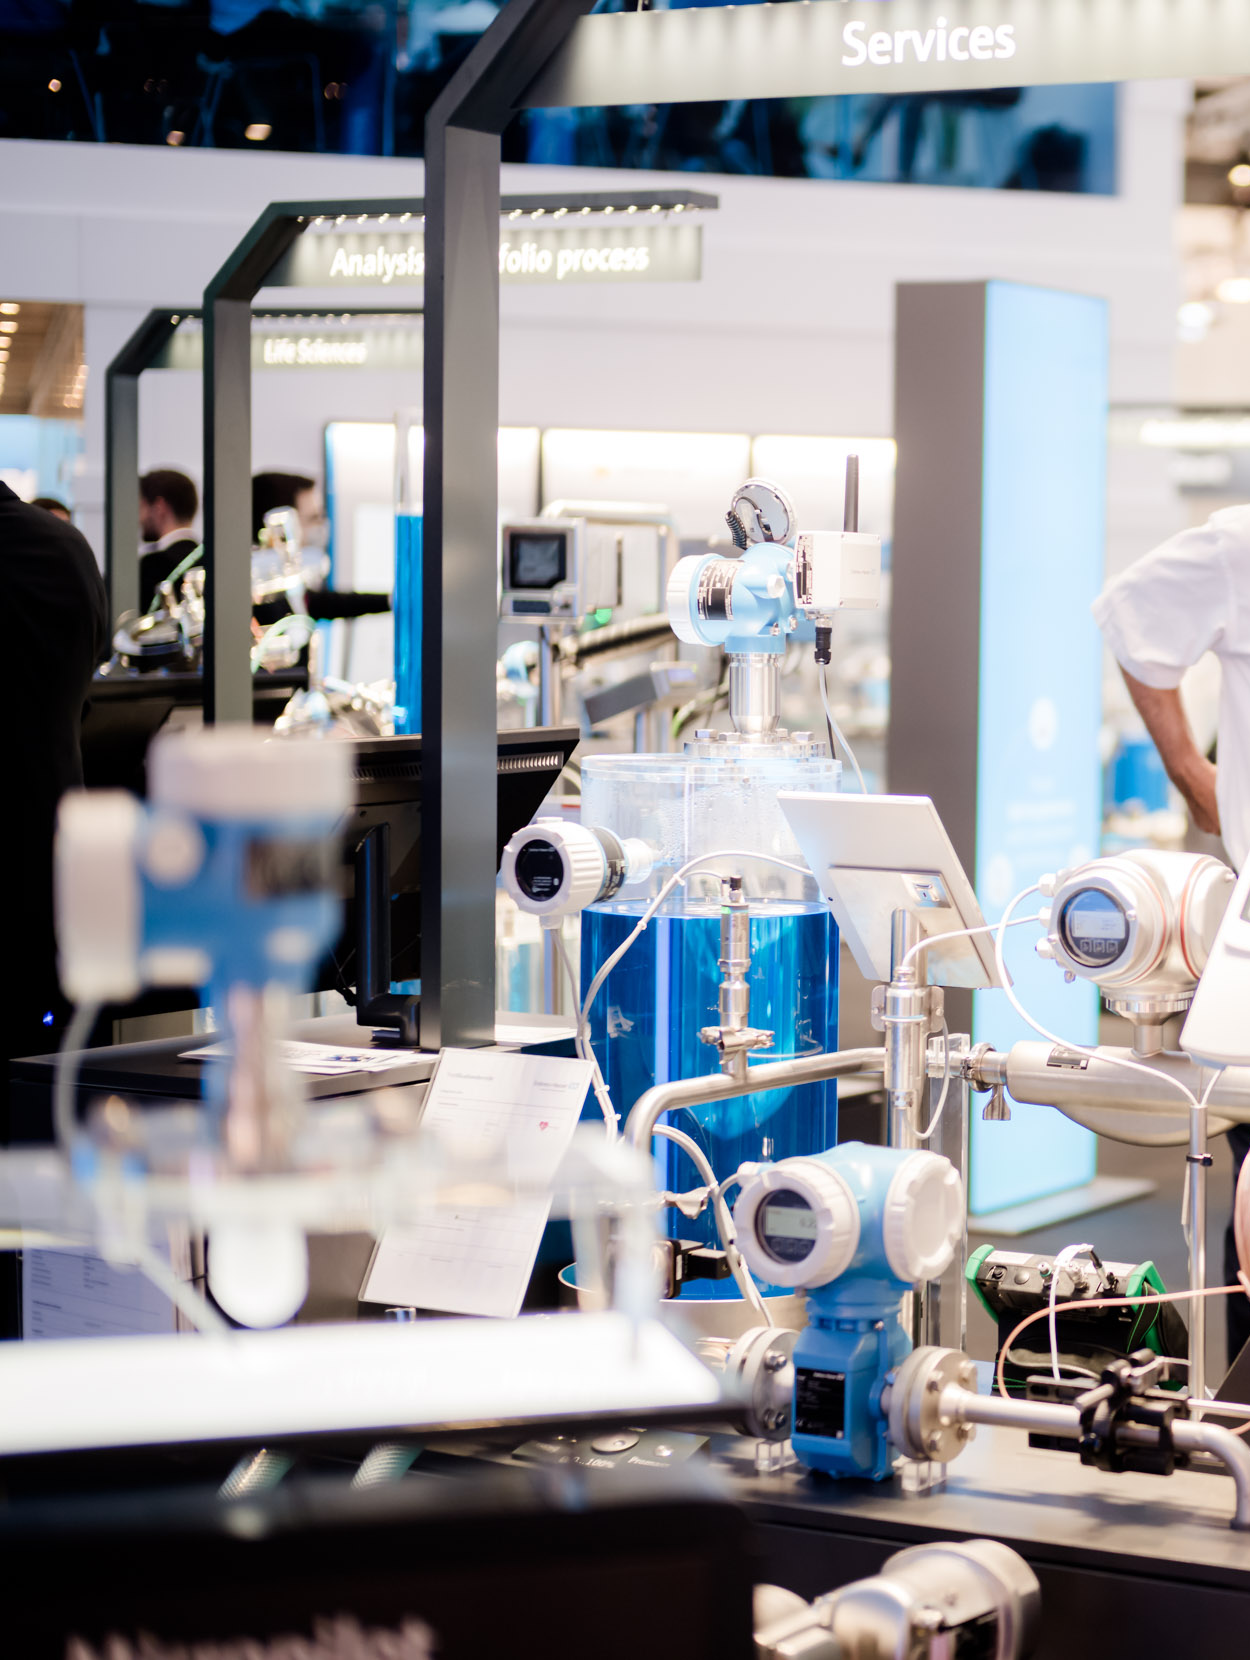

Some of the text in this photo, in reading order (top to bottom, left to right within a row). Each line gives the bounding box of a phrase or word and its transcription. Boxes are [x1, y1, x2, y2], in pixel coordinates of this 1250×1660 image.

[841, 15, 1017, 67] Services
[329, 241, 650, 283] Analysis folio process
[263, 337, 297, 365] Life
